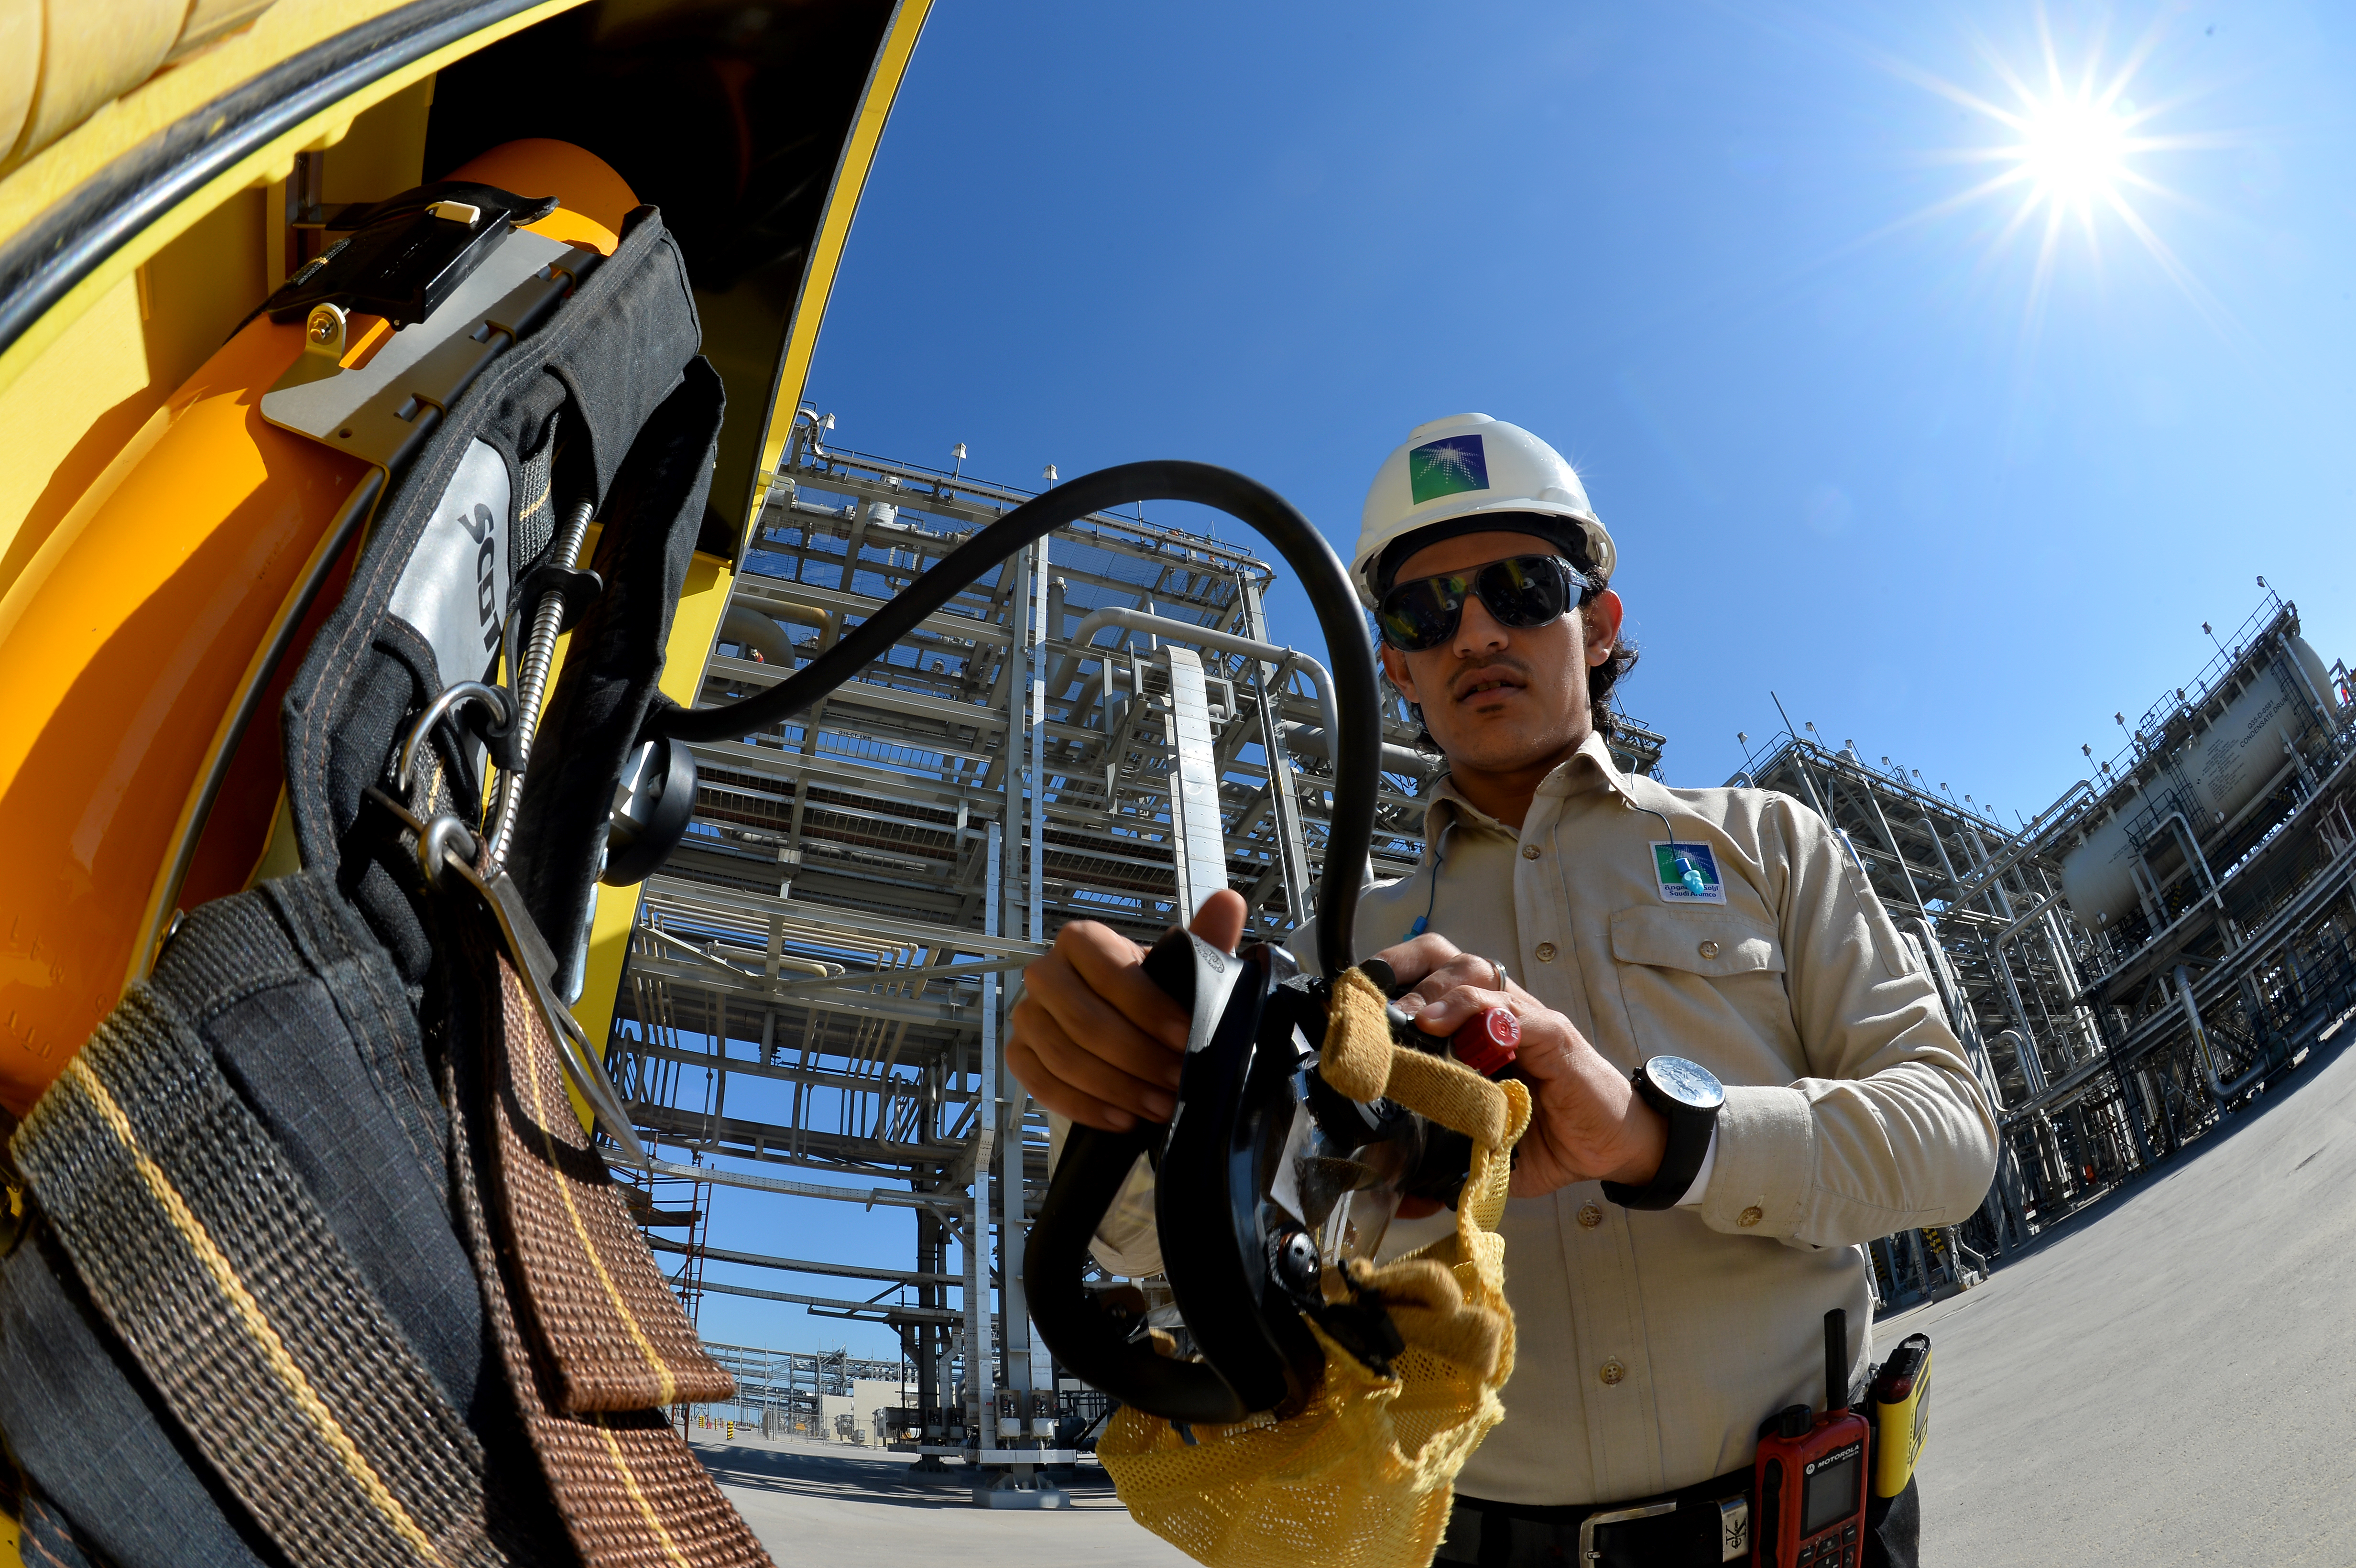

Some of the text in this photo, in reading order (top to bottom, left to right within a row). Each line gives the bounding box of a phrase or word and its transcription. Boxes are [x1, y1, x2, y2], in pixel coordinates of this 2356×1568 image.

[2240, 696, 2288, 748] CONDENSATE DRUM
[2247, 699, 2274, 729] Q35-D-0581
[1503, 1012, 1519, 1040] PURGE
[1818, 1445, 1859, 1468] MOTOROLA
